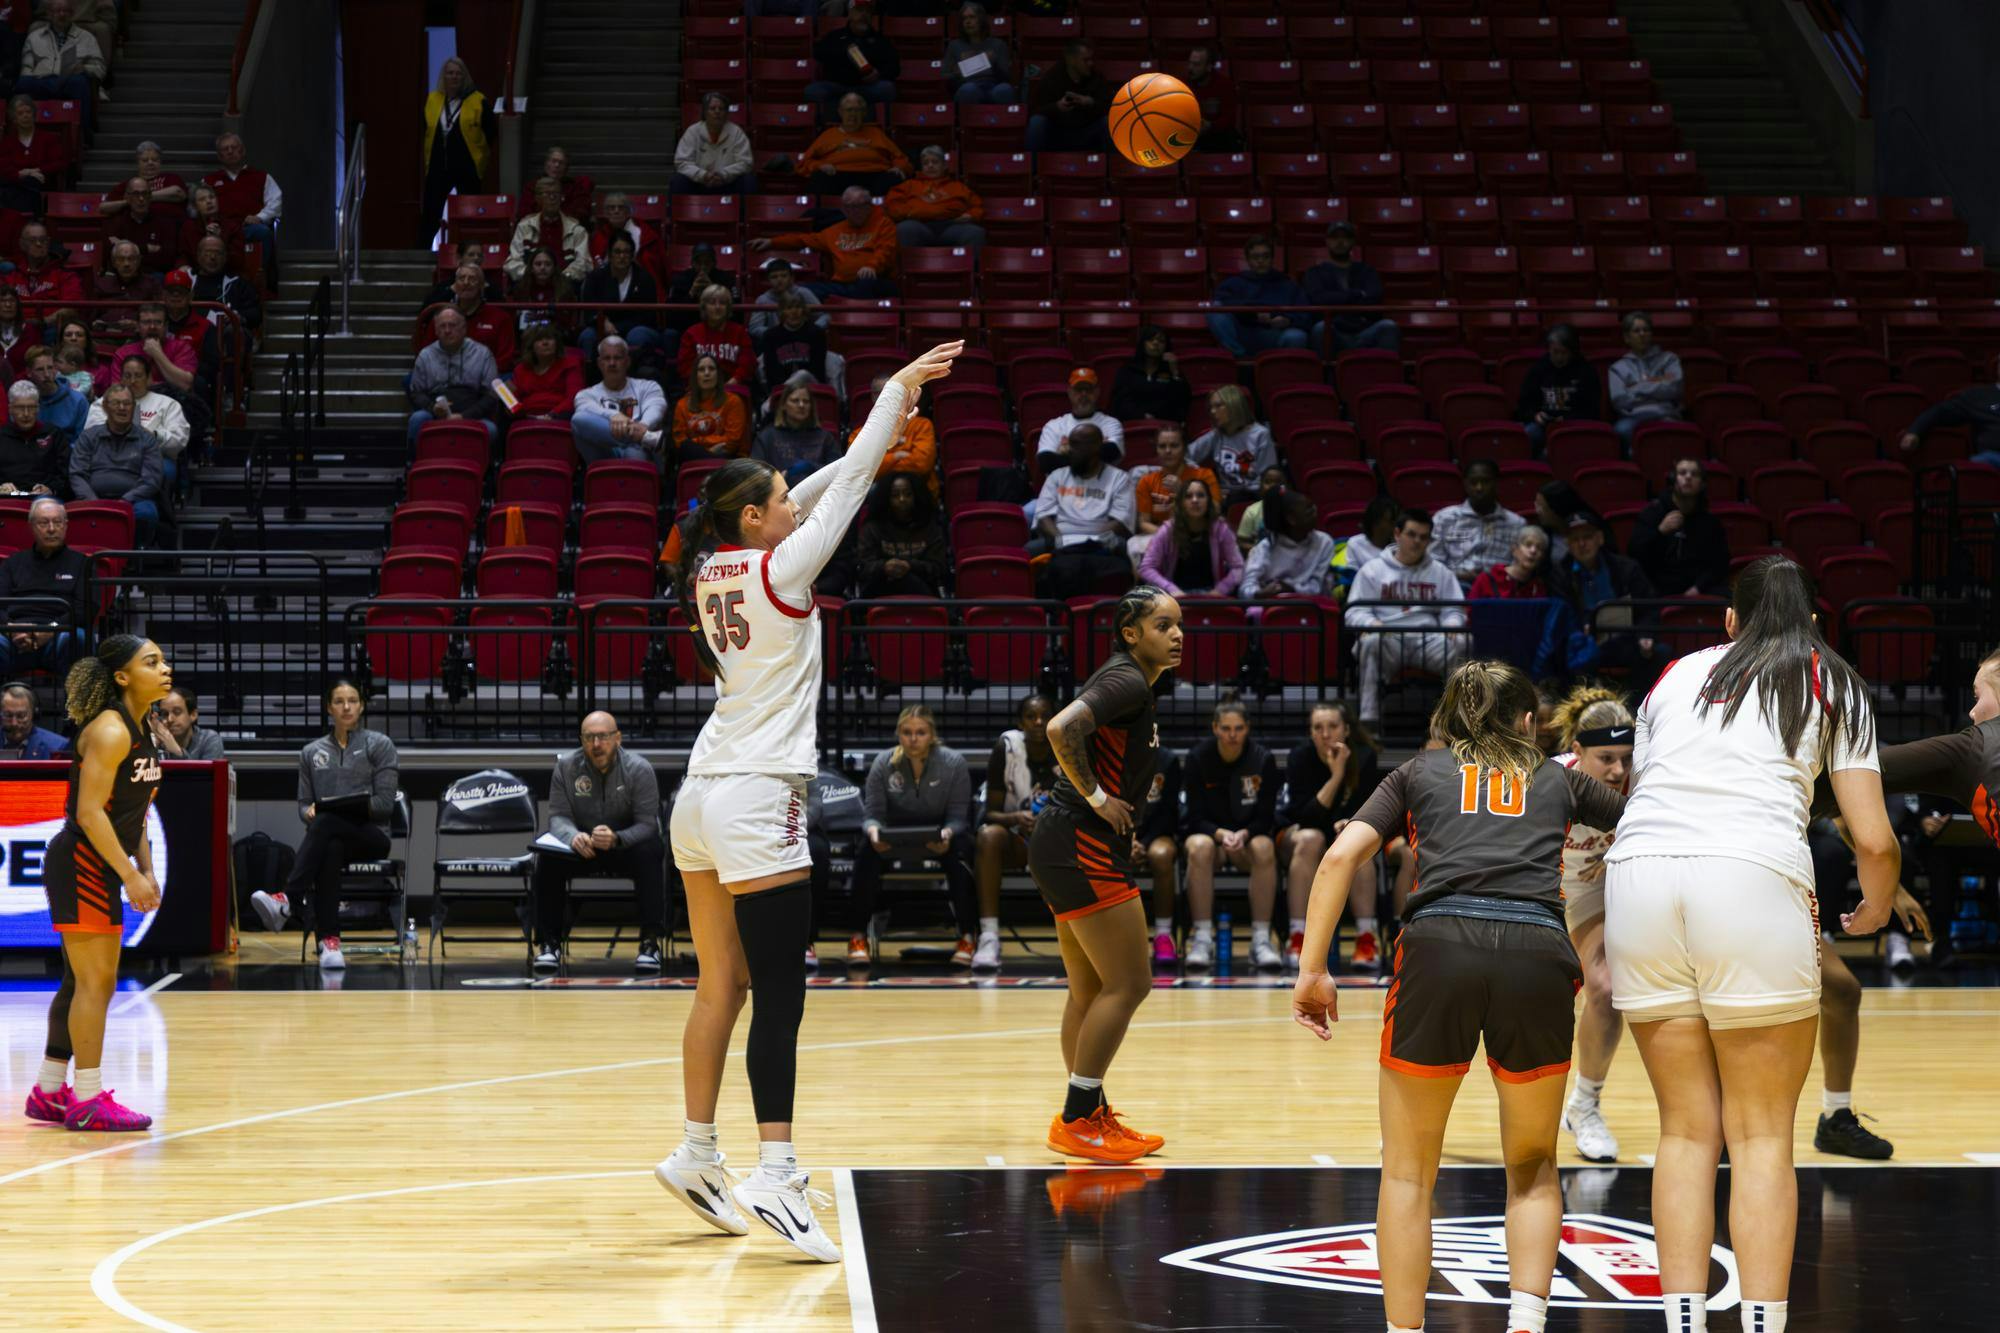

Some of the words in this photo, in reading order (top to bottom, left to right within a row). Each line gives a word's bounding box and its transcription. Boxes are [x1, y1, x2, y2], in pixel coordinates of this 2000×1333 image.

[705, 589, 750, 653] 35
[445, 786, 485, 802] Varsity
[486, 782, 528, 799] House
[1459, 763, 1527, 817] 10
[447, 864, 475, 872] BALL
[477, 864, 511, 872] STATE
[1589, 1247, 1658, 1270] 1946
